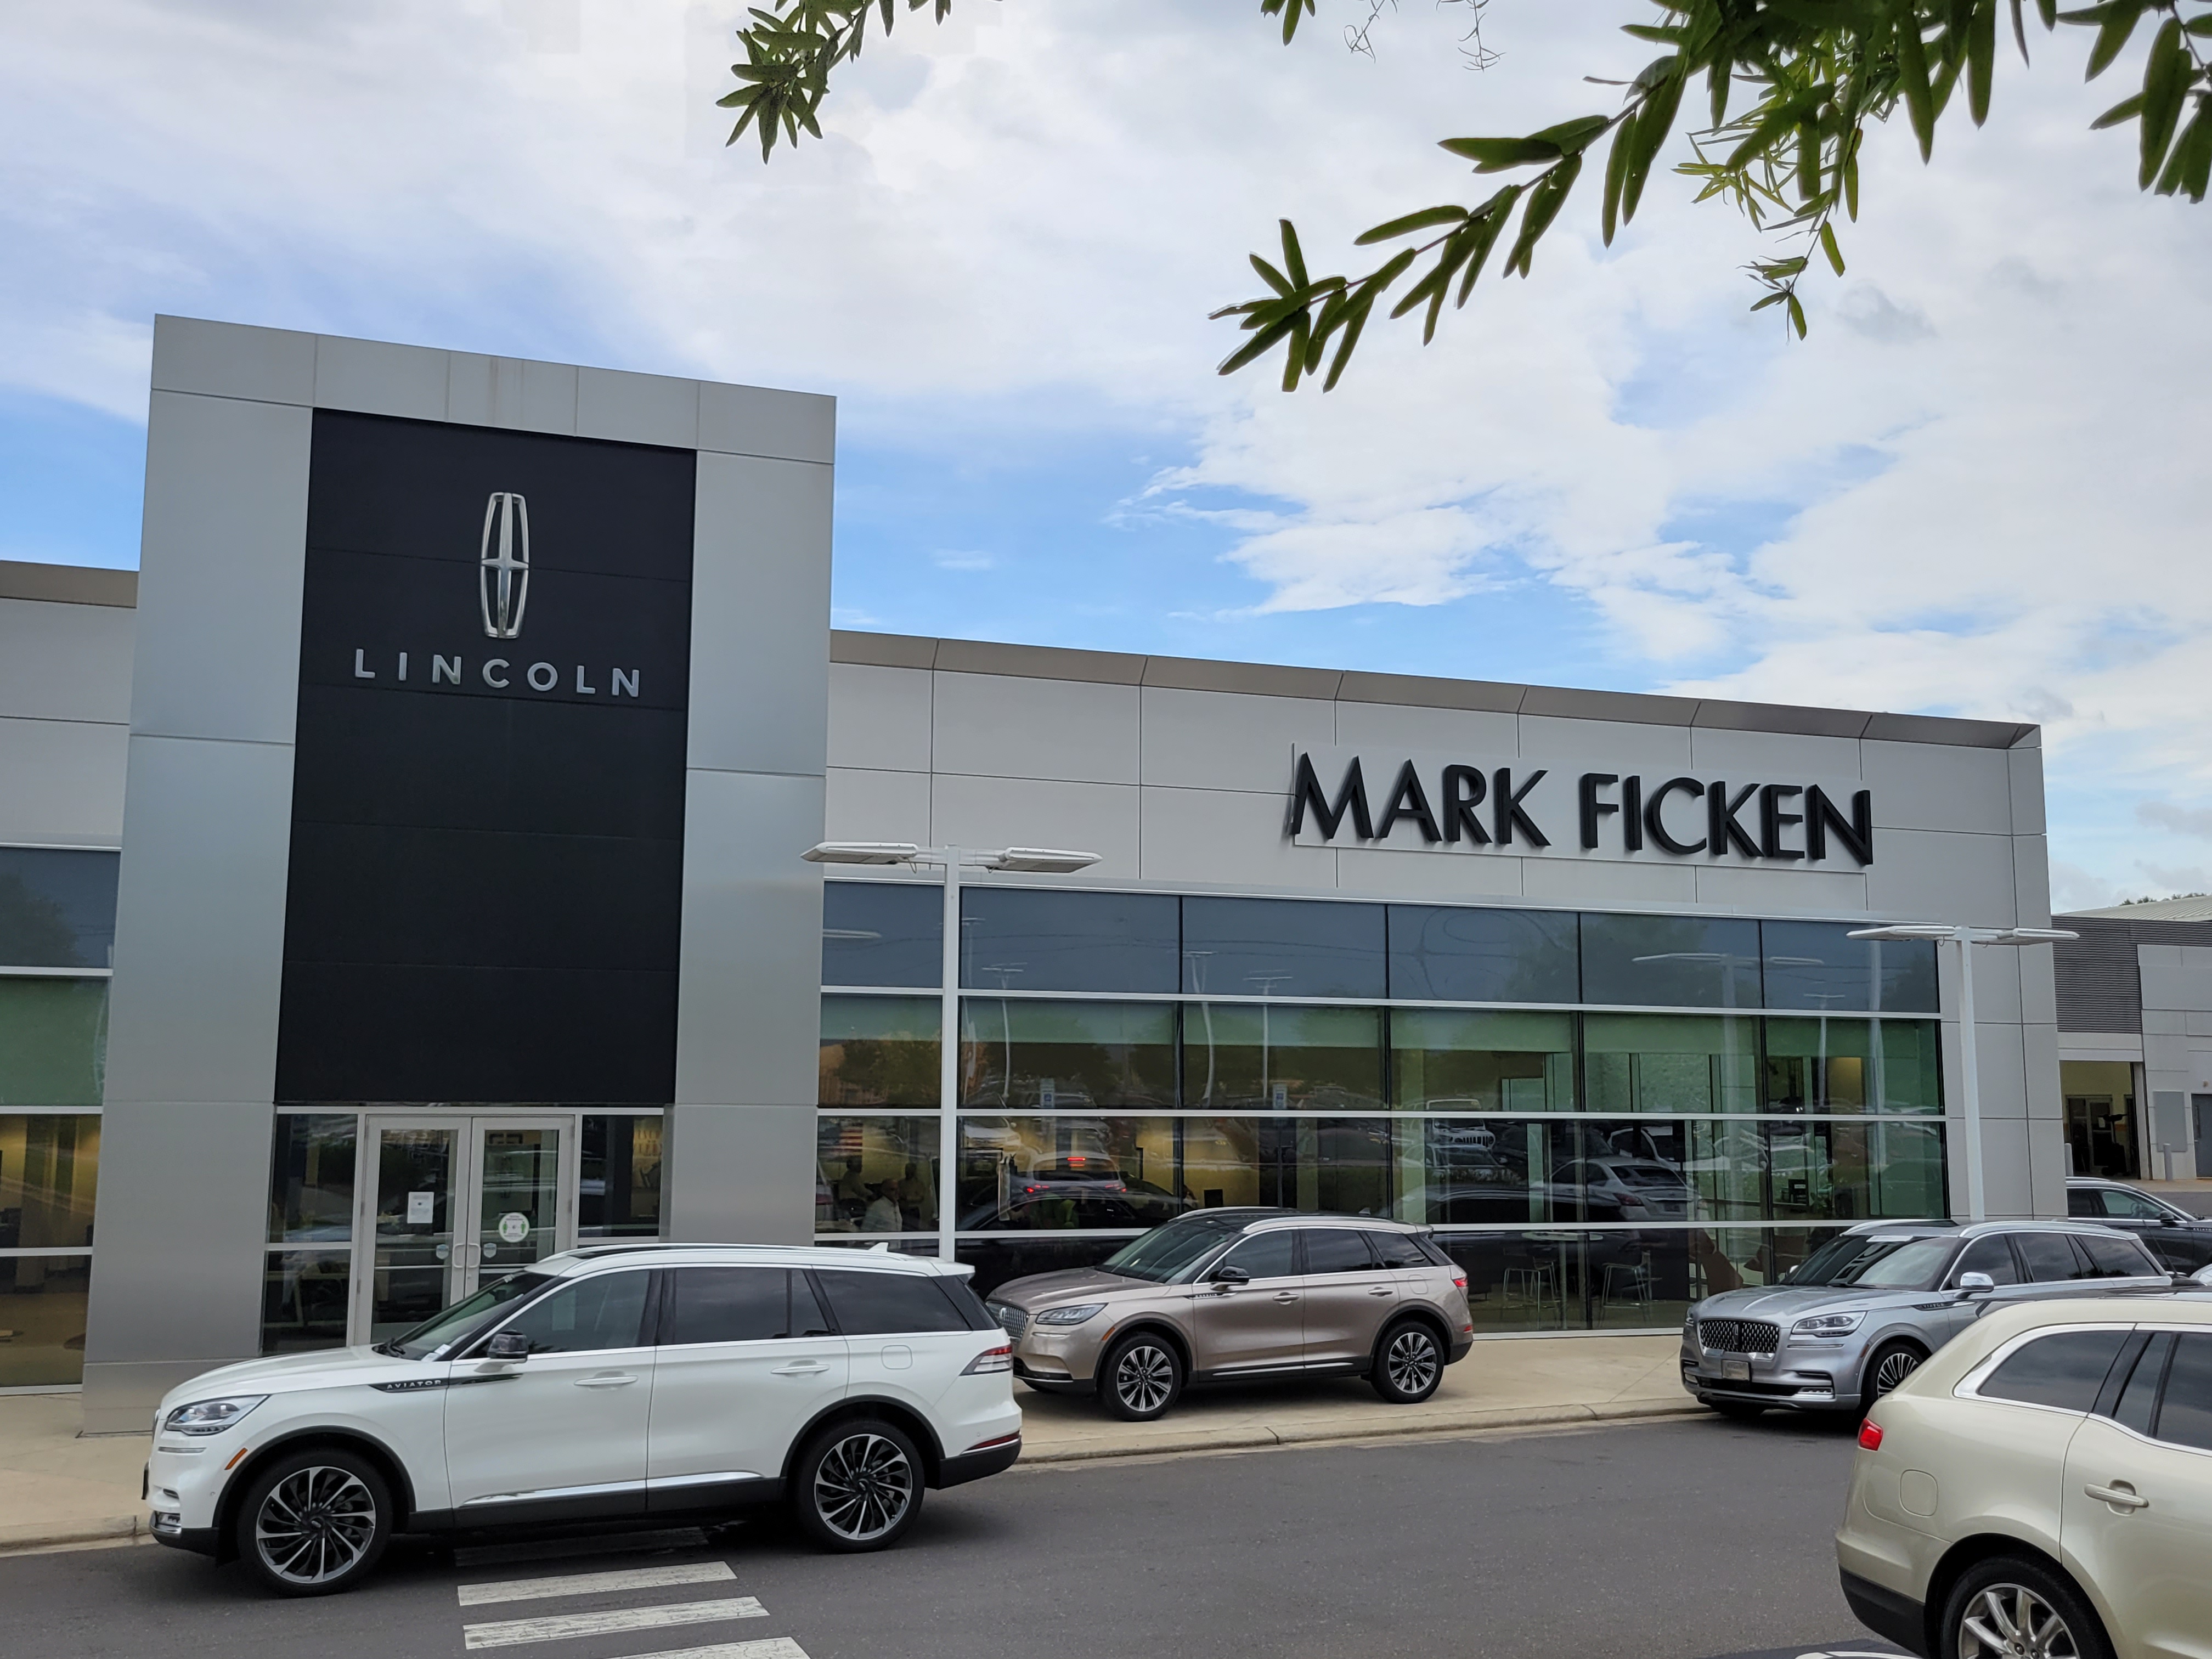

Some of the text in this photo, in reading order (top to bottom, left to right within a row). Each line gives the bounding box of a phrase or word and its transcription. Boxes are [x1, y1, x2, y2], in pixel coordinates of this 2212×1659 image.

[354, 648, 640, 698] LINCOLN
[1289, 752, 1874, 865] MARK FICKEN
[386, 1380, 442, 1390] AVIATOR
